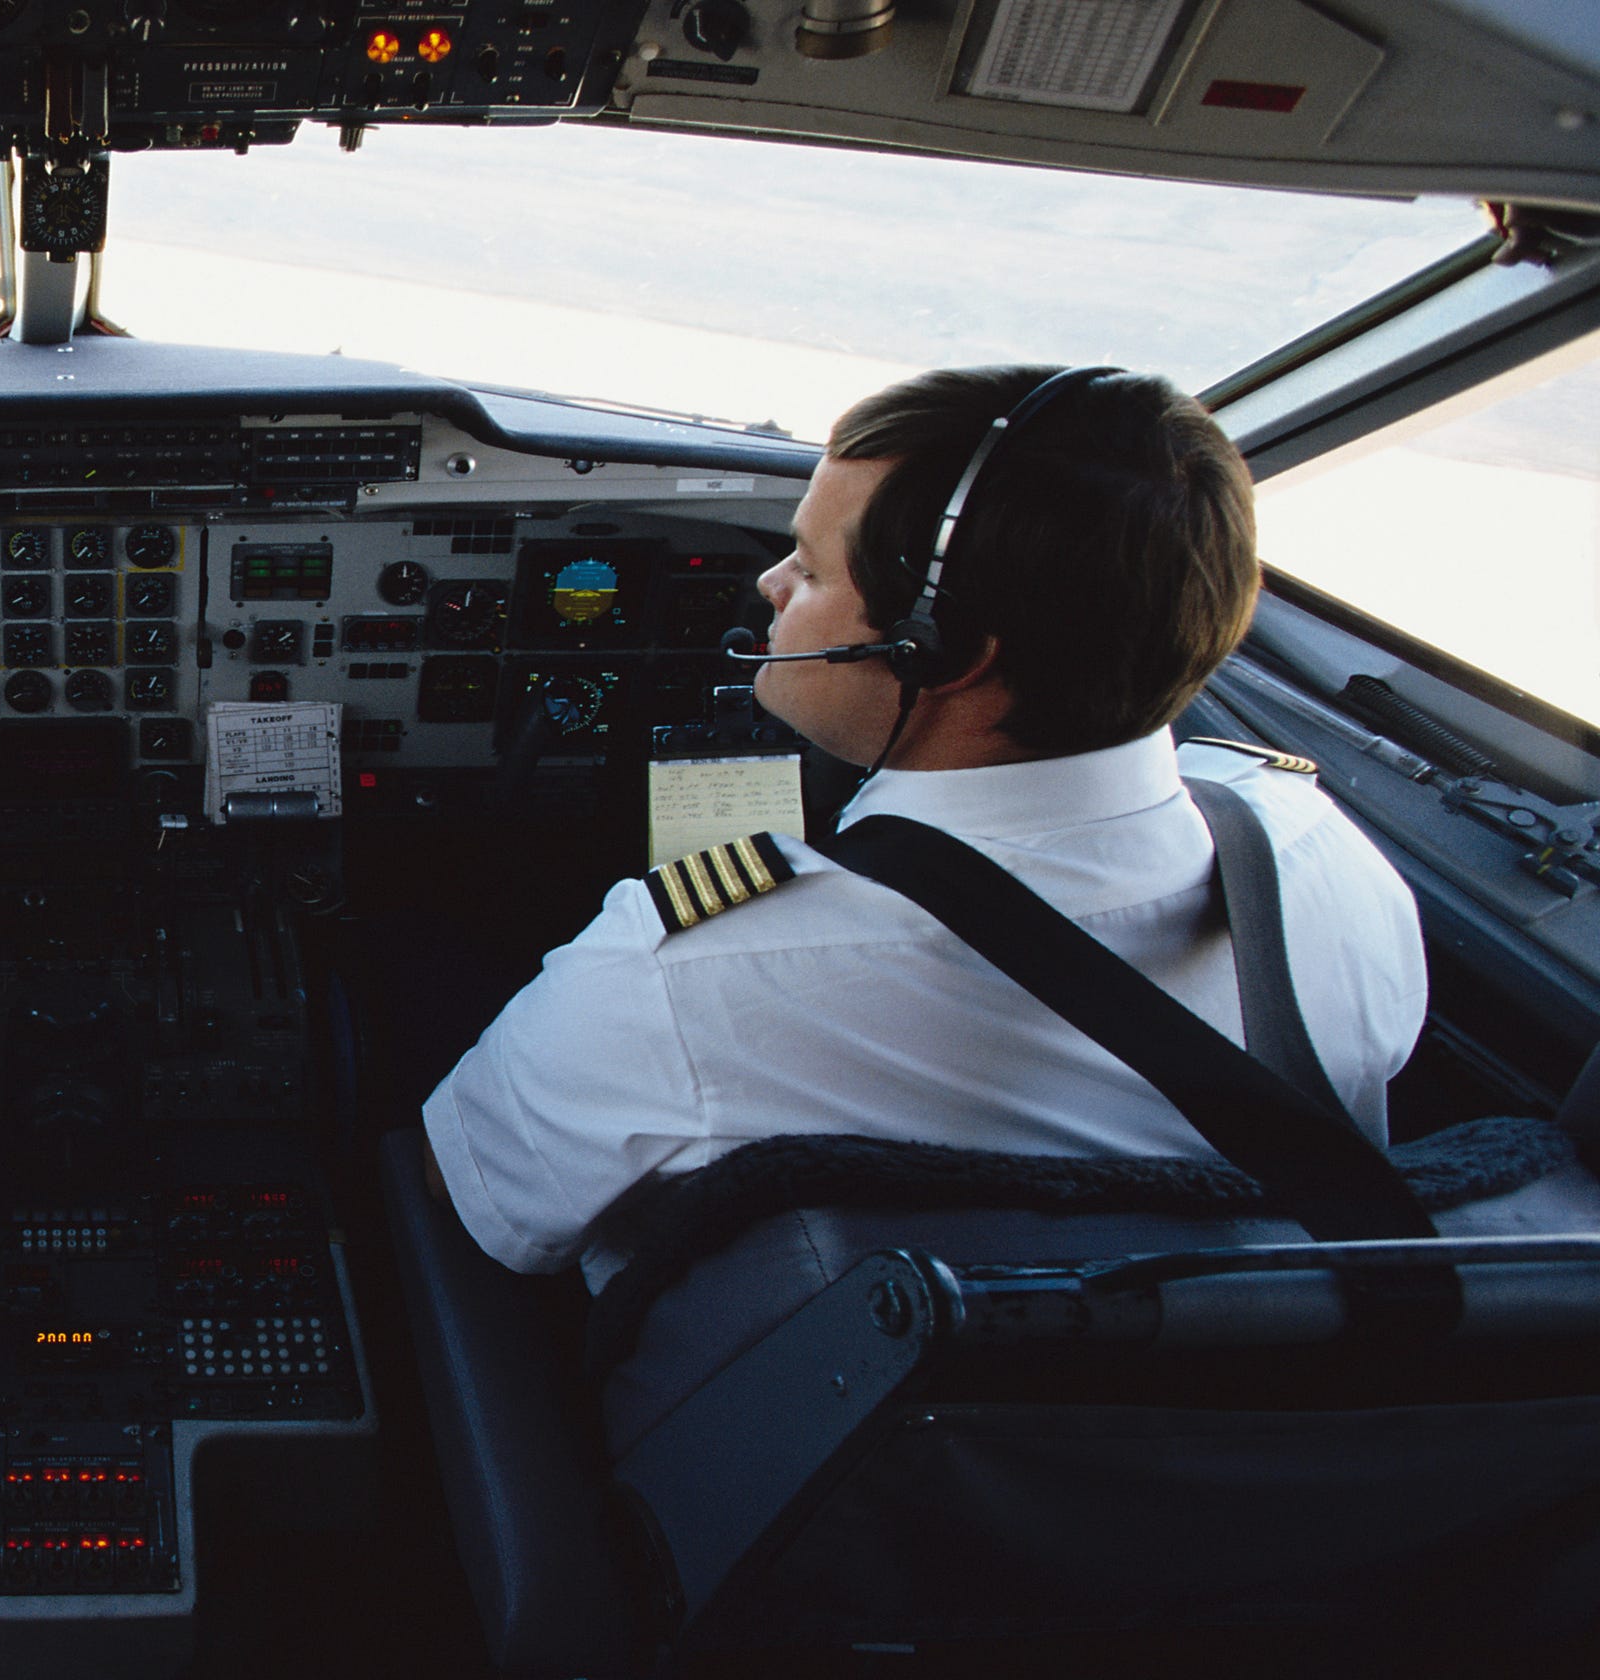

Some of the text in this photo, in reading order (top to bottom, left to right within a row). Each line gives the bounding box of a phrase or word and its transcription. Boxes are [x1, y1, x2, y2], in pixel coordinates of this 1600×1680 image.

[183, 62, 288, 72] PRESSURIZATION
[250, 714, 294, 724] TAKEOFF
[255, 774, 296, 784] LANDING
